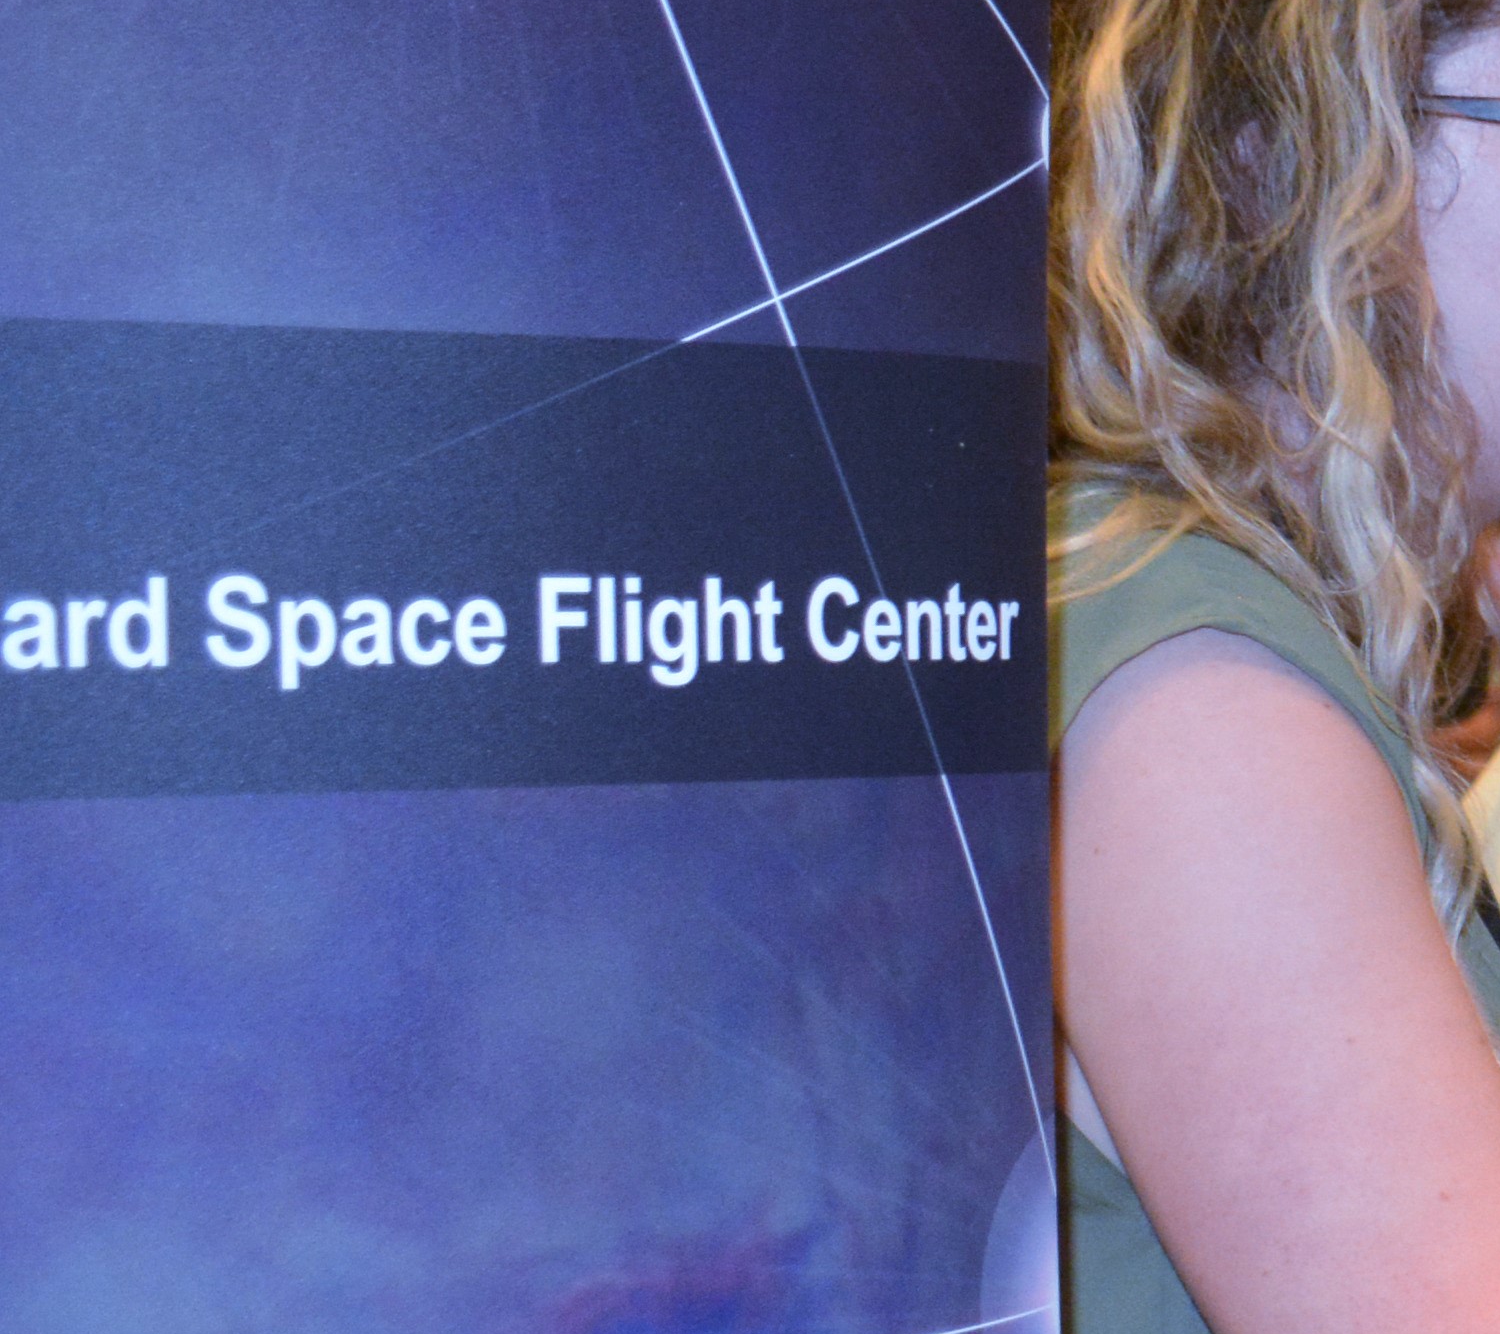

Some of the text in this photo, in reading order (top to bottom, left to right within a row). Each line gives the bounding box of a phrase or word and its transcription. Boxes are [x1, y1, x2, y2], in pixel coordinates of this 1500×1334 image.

[1, 575, 1020, 690] ard Space Flight Center
